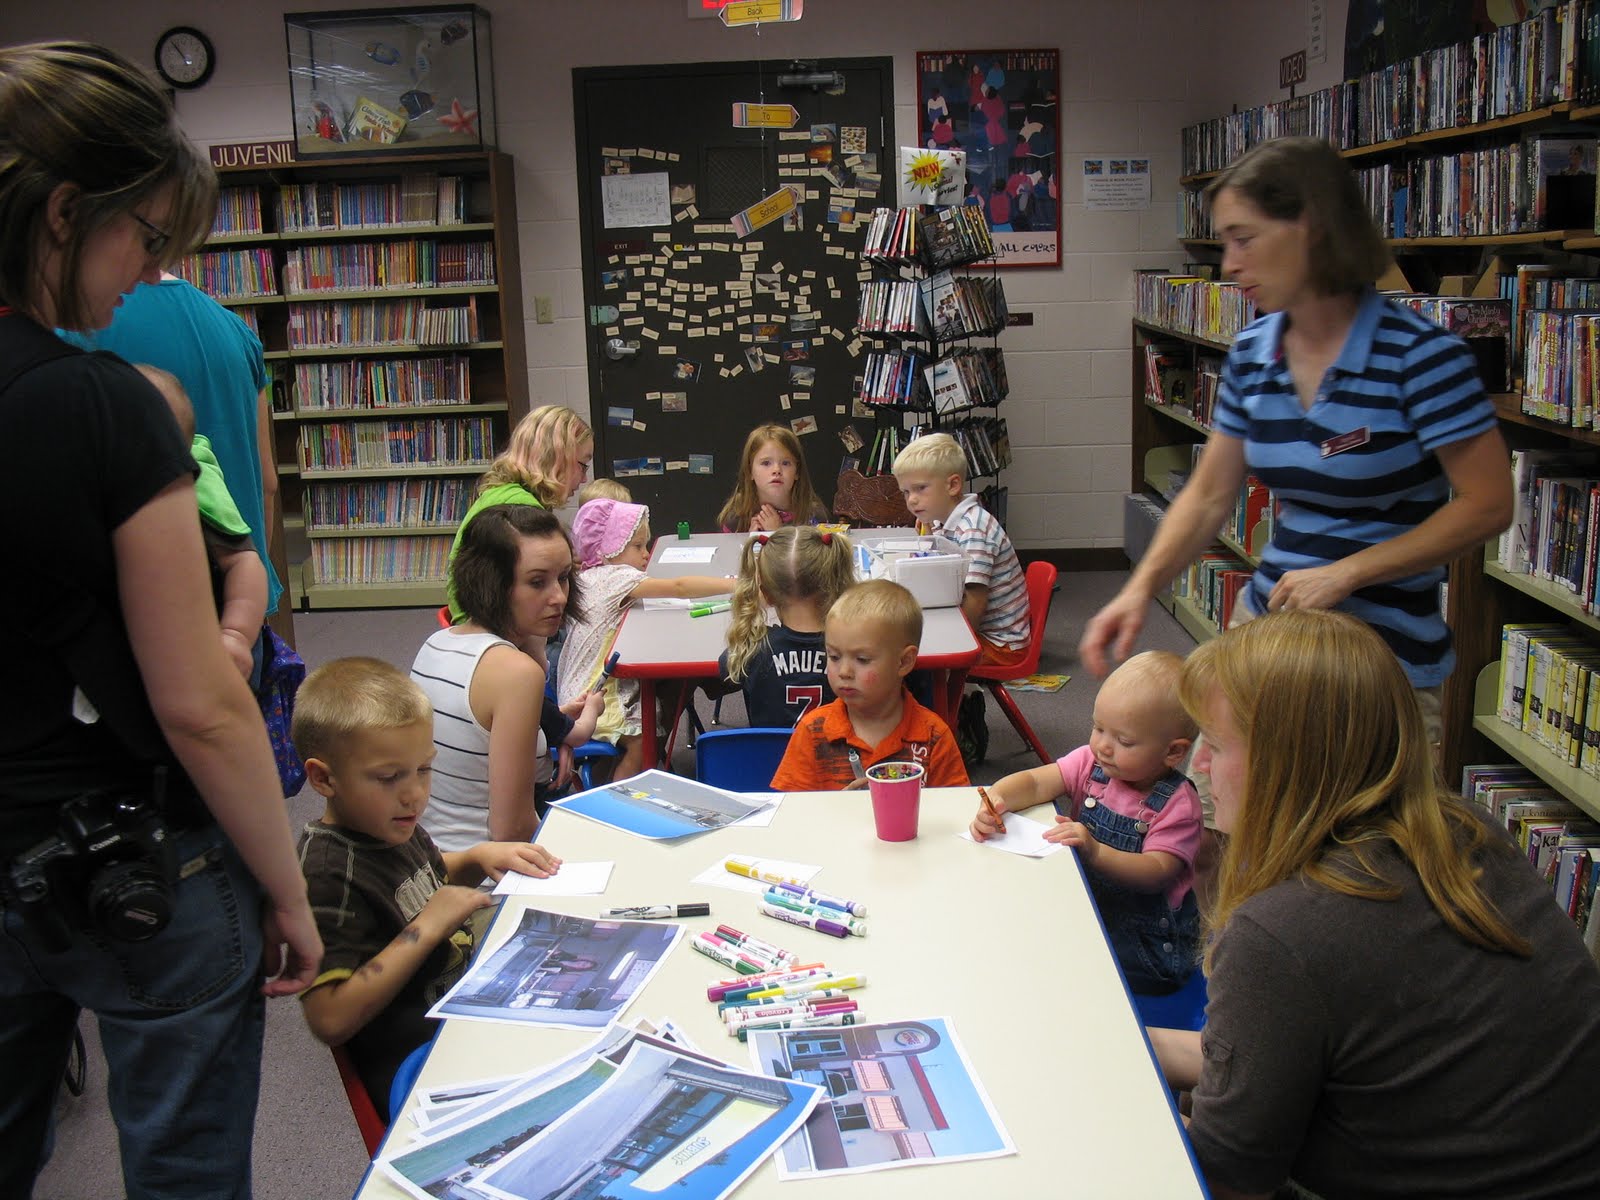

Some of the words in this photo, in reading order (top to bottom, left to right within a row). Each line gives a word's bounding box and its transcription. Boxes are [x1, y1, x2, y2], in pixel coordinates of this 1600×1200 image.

[747, 7, 763, 16] Back
[1280, 54, 1304, 85] VIDEO
[762, 112, 771, 120] To
[213, 143, 296, 168] JUVENIL
[911, 161, 940, 181] NEW
[760, 203, 779, 218] School
[1022, 243, 1056, 253] COLORS
[785, 684, 823, 730] 7
[89, 834, 121, 851] Canon
